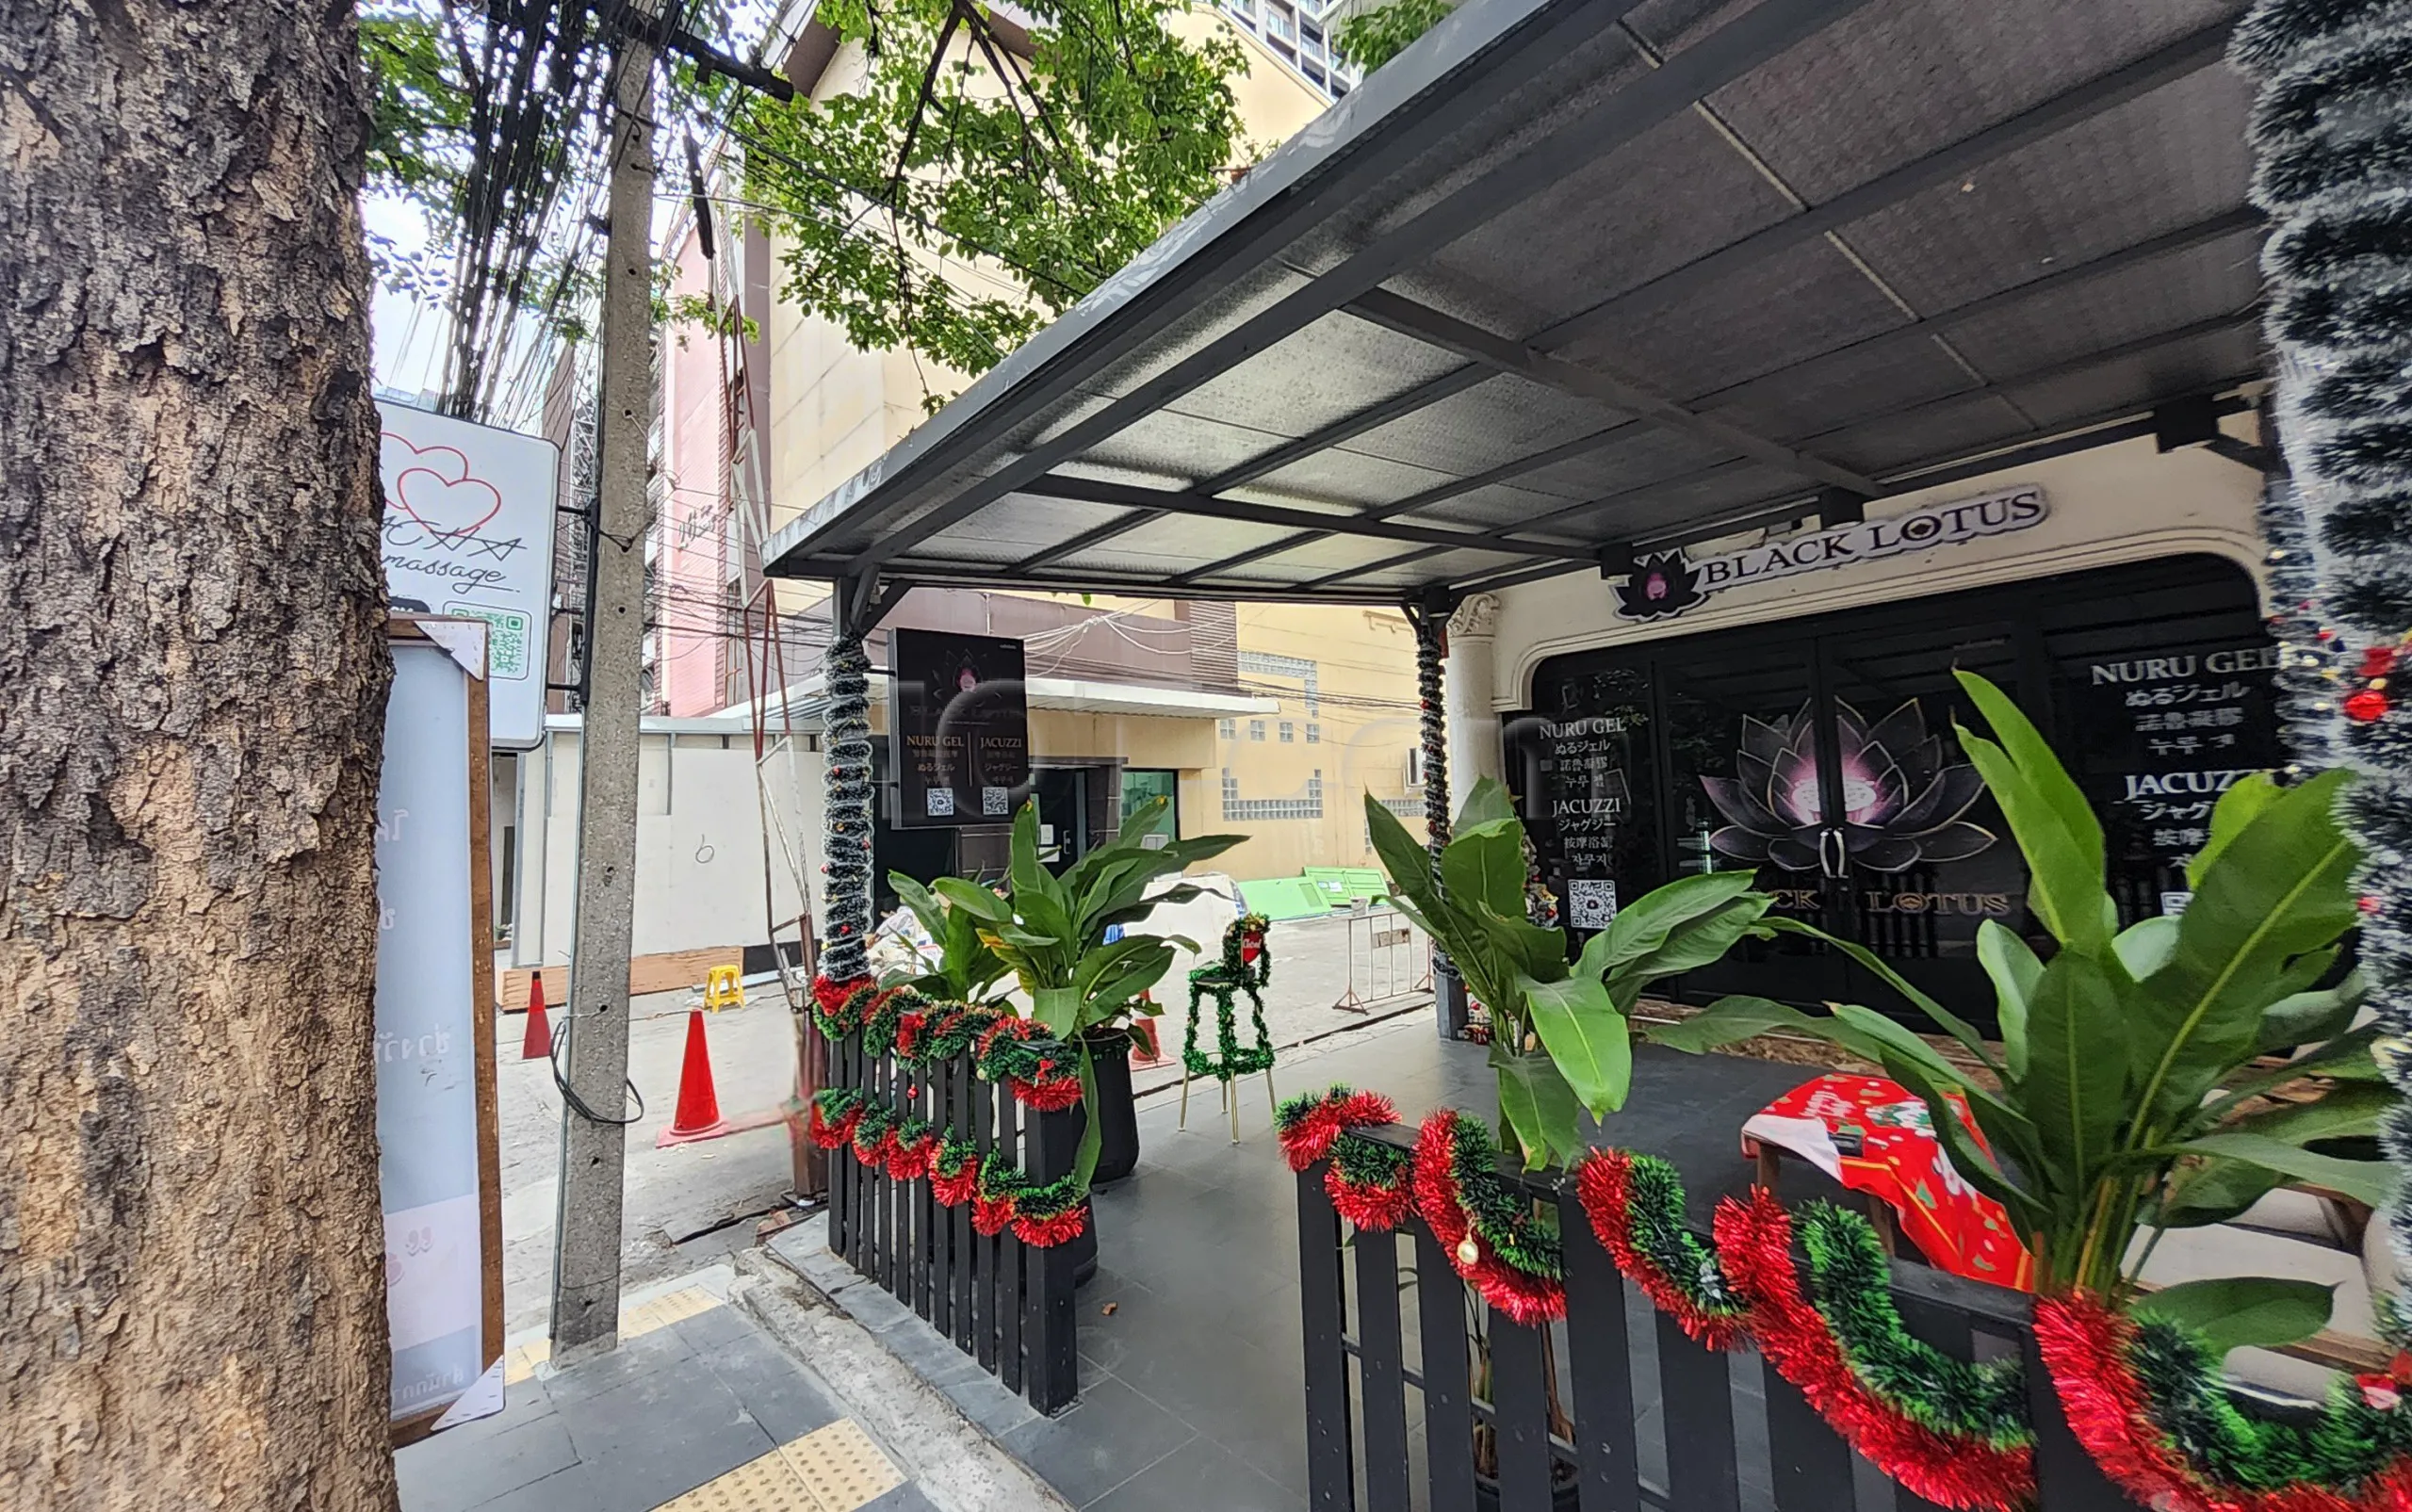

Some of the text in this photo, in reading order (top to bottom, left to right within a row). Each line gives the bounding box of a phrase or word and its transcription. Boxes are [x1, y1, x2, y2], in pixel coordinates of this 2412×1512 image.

[1704, 493, 2040, 584] BLACK LOTUS
[382, 554, 520, 595] massage
[2092, 646, 2281, 685] NURU GEL
[2126, 682, 2250, 707] ぬるジェル
[1539, 717, 1627, 740] NURU GEL
[906, 735, 1022, 750] NURU GEL JACUZZI
[1555, 739, 1611, 756] ぬるジェル
[2124, 769, 2258, 802] JACUZ
[1552, 797, 1622, 818] JACUZZI
[2139, 801, 2216, 821] ジャグ
[1557, 817, 1617, 833] ジャグジー
[1866, 891, 2011, 916] LOTUS
